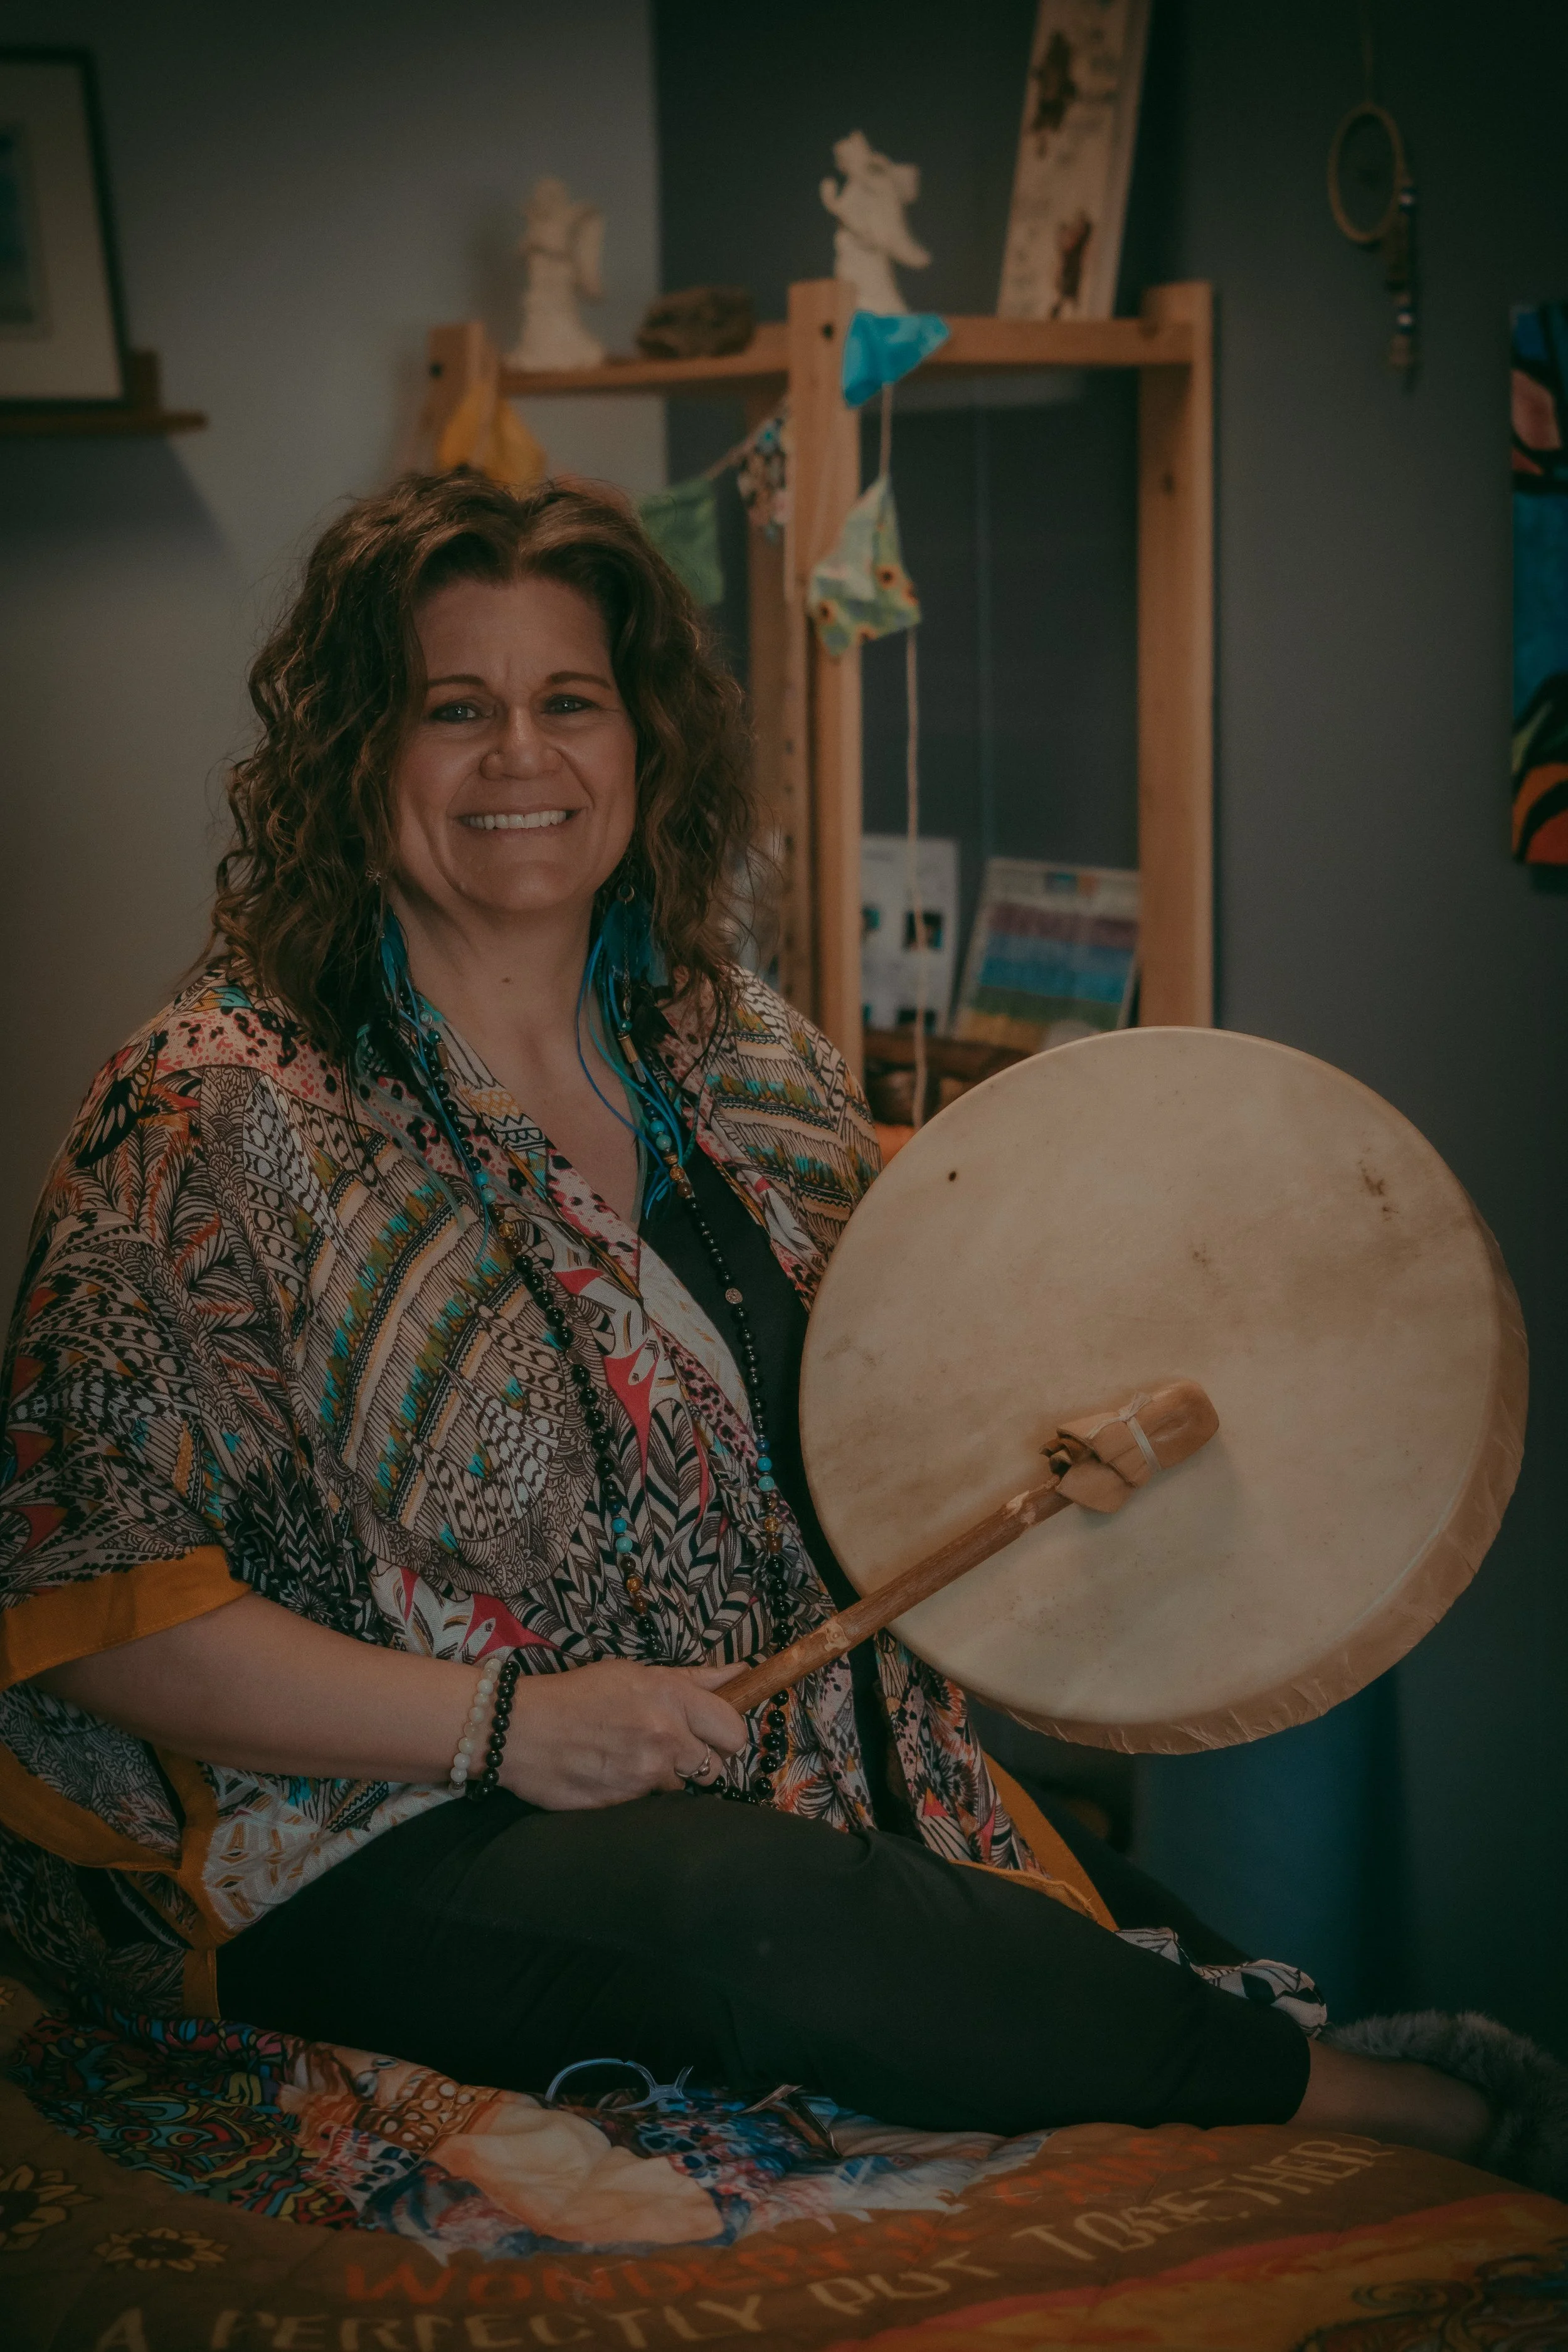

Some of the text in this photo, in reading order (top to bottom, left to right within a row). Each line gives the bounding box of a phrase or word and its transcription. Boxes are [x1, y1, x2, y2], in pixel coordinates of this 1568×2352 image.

[95, 2306, 151, 2352] A
[209, 2293, 763, 2352] PERFECTLY
[807, 2250, 1000, 2316] PUT
